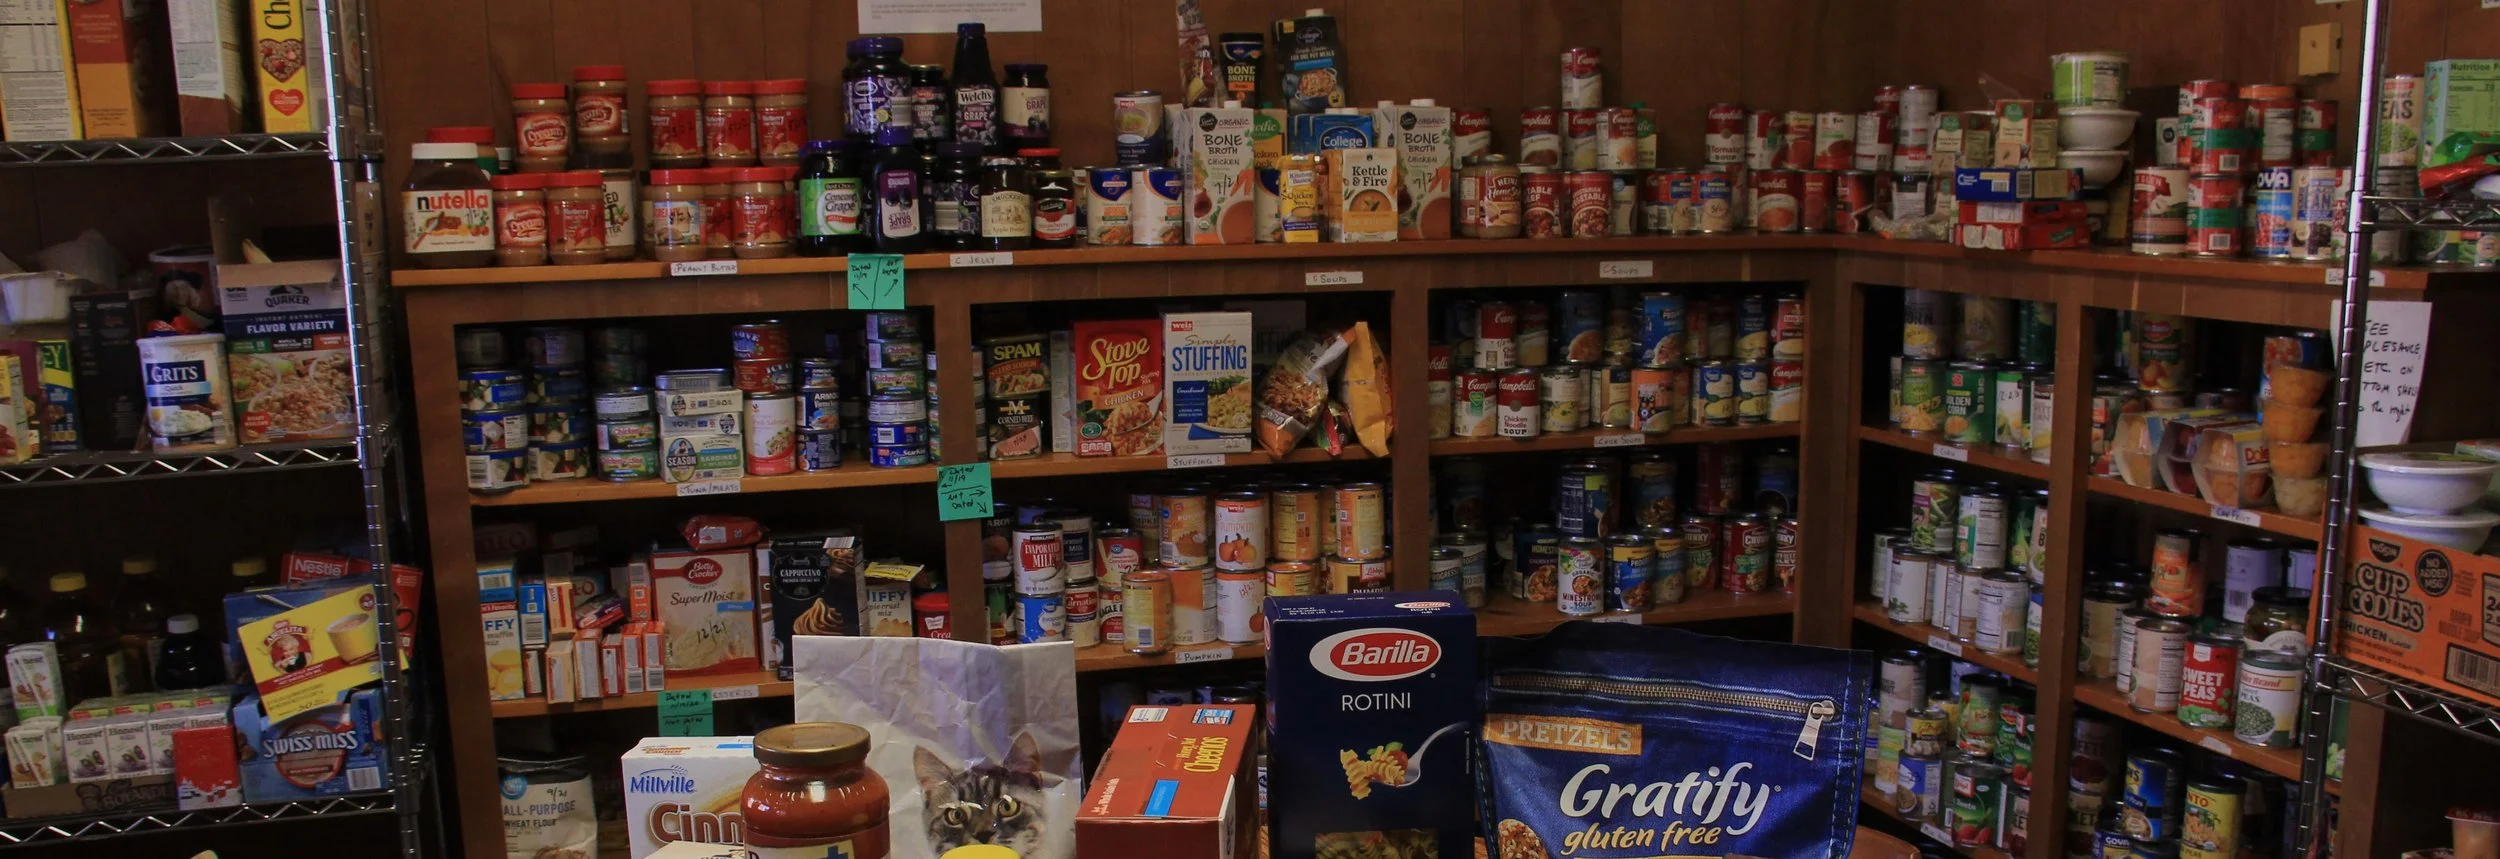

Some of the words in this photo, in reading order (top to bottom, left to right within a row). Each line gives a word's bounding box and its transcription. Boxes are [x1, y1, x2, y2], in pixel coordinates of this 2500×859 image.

[1228, 66, 1256, 75] BONE
[2450, 63, 2491, 71] Nutrition
[960, 89, 992, 102] Welch's
[964, 112, 988, 121] GRAPE
[2381, 101, 2413, 119] EAS
[1203, 134, 1242, 145] BONE
[1323, 136, 1363, 147] College
[1404, 133, 1440, 143] BONE
[1352, 166, 1388, 176] Kettle
[1353, 177, 1362, 186] &
[1363, 176, 1388, 186] Fire
[417, 190, 488, 210] nutella
[826, 202, 856, 214] Grape
[265, 295, 310, 308] QUAKER
[247, 323, 286, 334] FLAVOR
[290, 320, 335, 331] VARIETY
[1185, 334, 1237, 349] Simply
[994, 342, 1041, 360] SPAM
[1083, 337, 1150, 381] Stove
[1171, 345, 1247, 373] STUFFING
[151, 366, 199, 382] GRITS
[1108, 362, 1141, 389] Top
[1104, 389, 1144, 405] CHICKEN
[1008, 400, 1025, 415] M
[997, 415, 1020, 424] CORNED
[1022, 414, 1034, 423] BEEF
[1504, 415, 1528, 423] Chicken
[667, 456, 697, 467] SEASON
[1172, 457, 1212, 467] STUFFING
[693, 562, 714, 572] Betty
[2426, 558, 2440, 567] NO
[780, 569, 822, 577] CAPPUCCINO
[2420, 570, 2449, 578] ADDED
[2358, 564, 2410, 597] CUP
[2424, 578, 2445, 589] MSG
[484, 618, 514, 632] FFY
[1184, 652, 1223, 661] PUMPKIN
[1340, 640, 1431, 666] Barilla
[2182, 667, 2224, 687] SWEET
[2183, 686, 2217, 701] PEAS
[1342, 692, 1411, 712] ROTINI
[1501, 720, 1633, 751] PRETZELS
[263, 734, 313, 757] SWISS
[317, 730, 357, 751] MISS
[1183, 736, 1228, 773] Cheerios
[630, 775, 695, 794] Millville
[1559, 761, 1770, 835] Gratify
[503, 800, 576, 816] ALL-PURPOSE
[649, 802, 744, 845] Cinn
[1563, 822, 1653, 855] gluten
[1661, 820, 1723, 854] free
